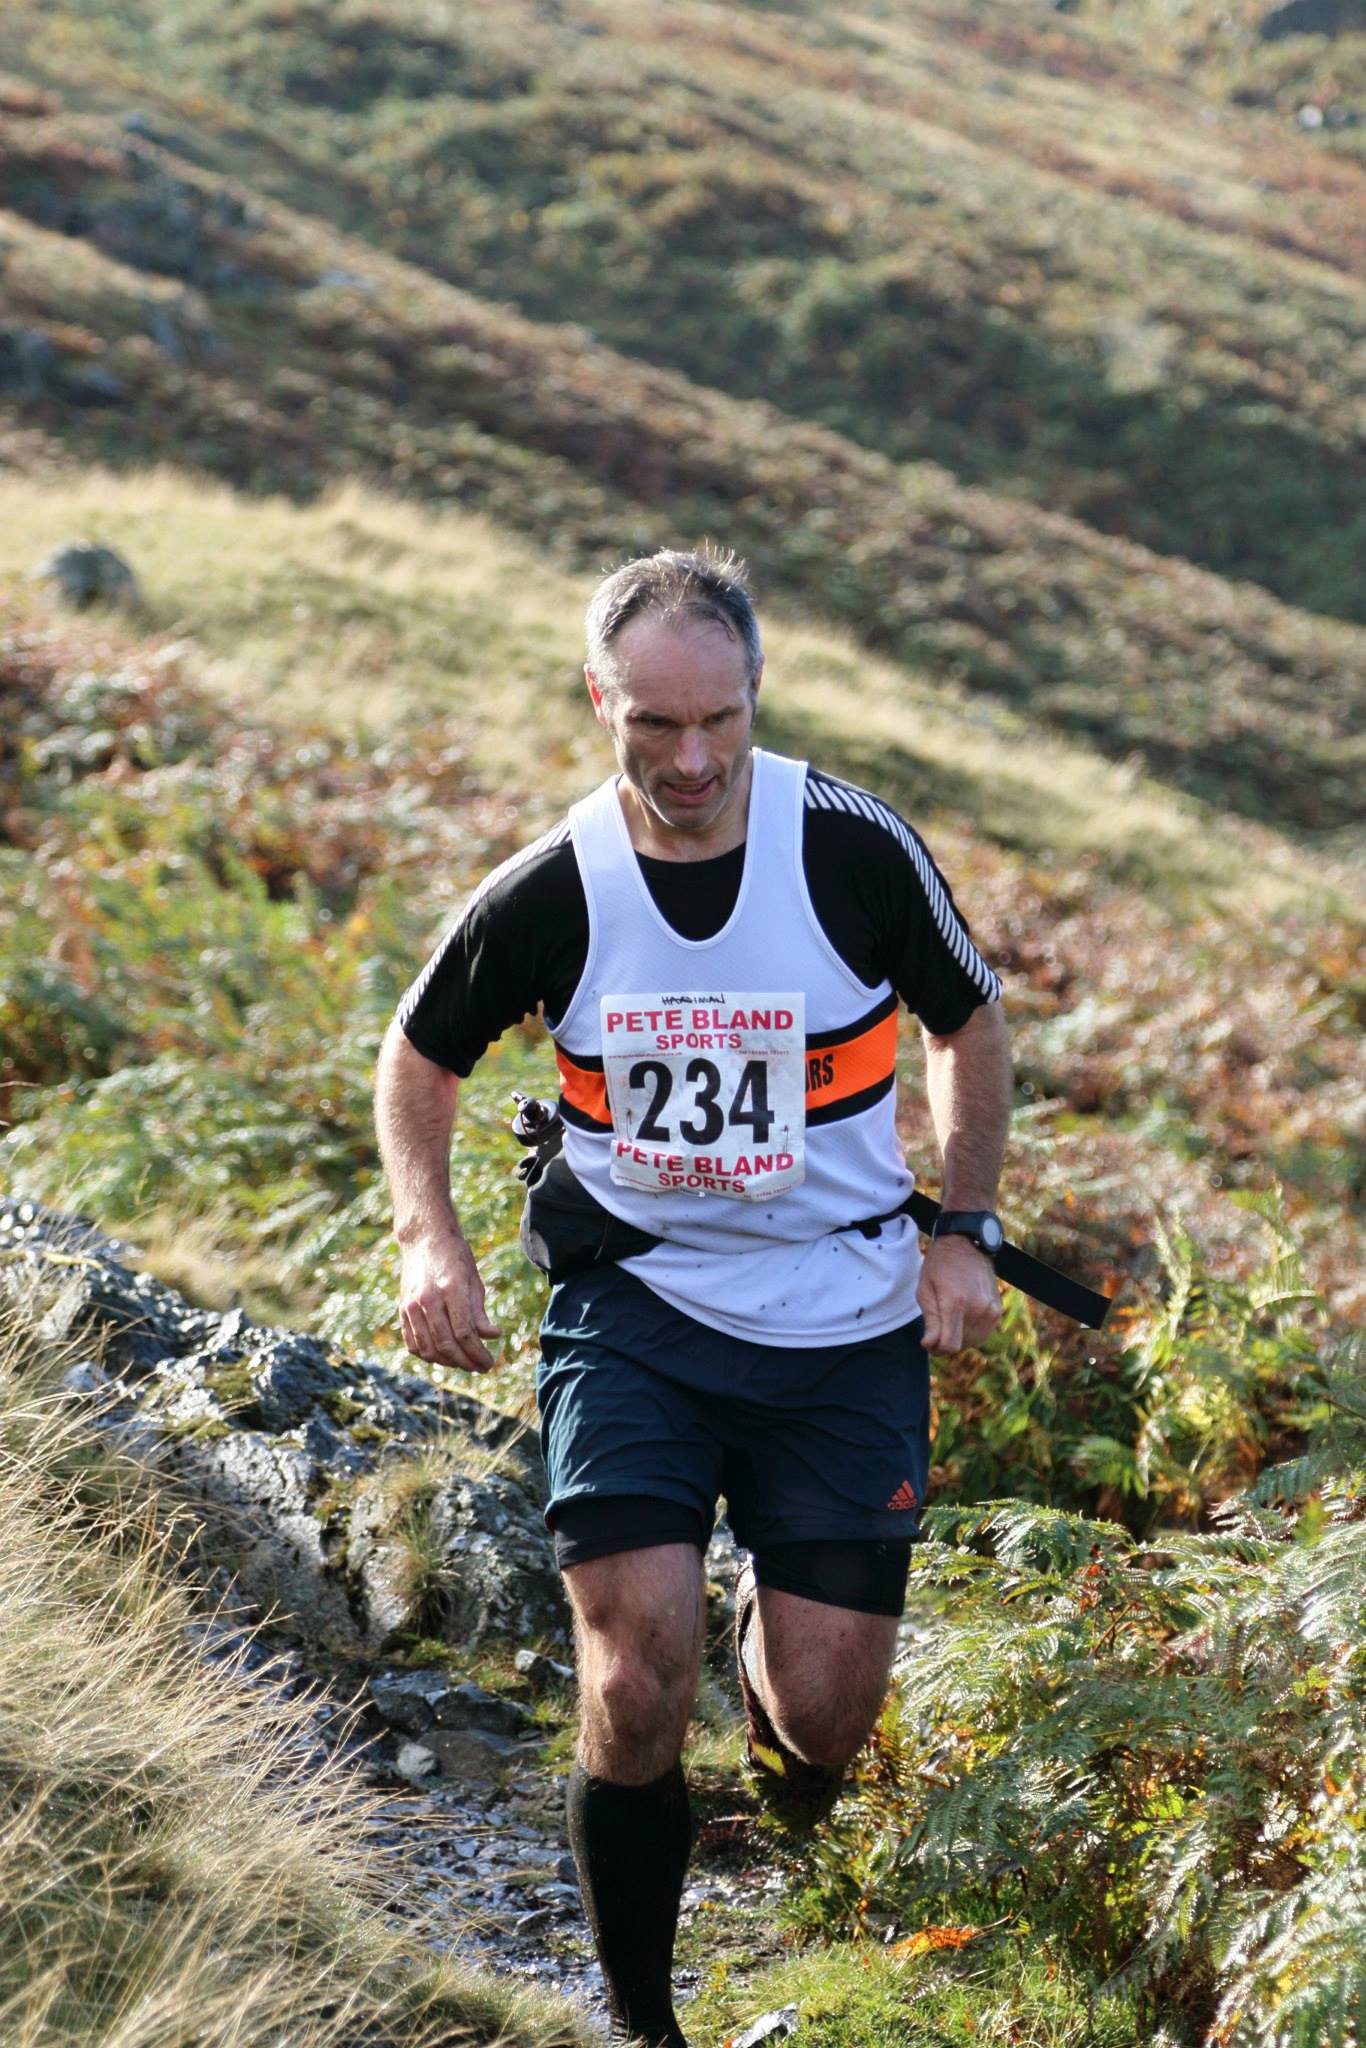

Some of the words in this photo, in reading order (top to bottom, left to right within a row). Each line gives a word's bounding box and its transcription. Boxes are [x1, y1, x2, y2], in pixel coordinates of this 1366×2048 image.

[607, 1010, 683, 1032] PETE
[691, 1009, 794, 1030] BLAND
[655, 1033, 743, 1050] SPORTS
[805, 1053, 834, 1092] RS
[629, 1058, 775, 1145] 234
[616, 1142, 684, 1171] PETE
[694, 1152, 794, 1176] BLAND
[658, 1172, 745, 1193] SPORTS
